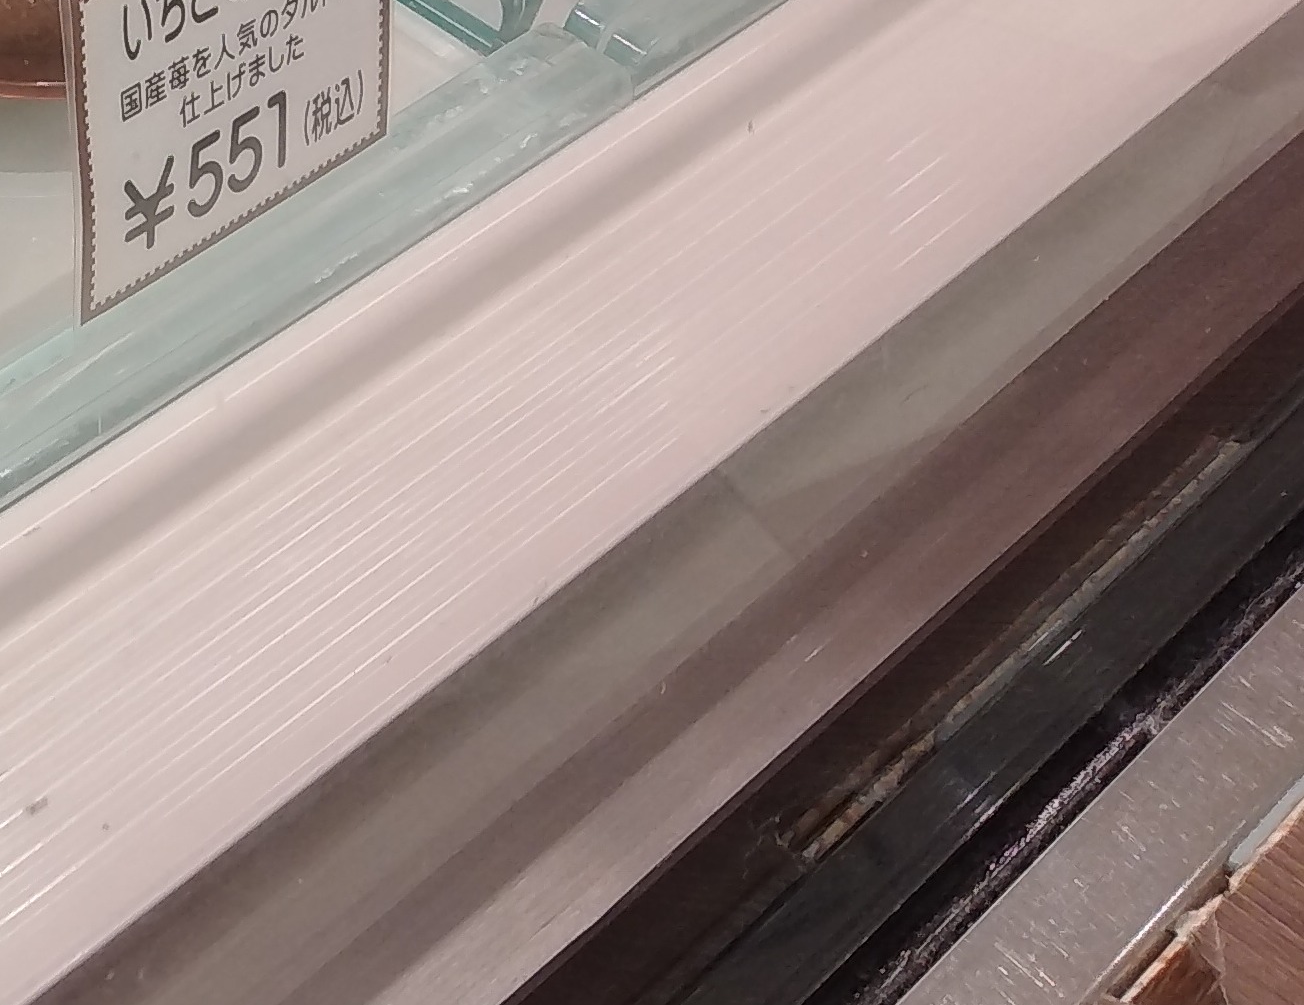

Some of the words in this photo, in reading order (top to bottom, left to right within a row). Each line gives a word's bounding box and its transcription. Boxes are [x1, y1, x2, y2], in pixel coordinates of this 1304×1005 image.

[179, 34, 306, 127] 仕上げました
